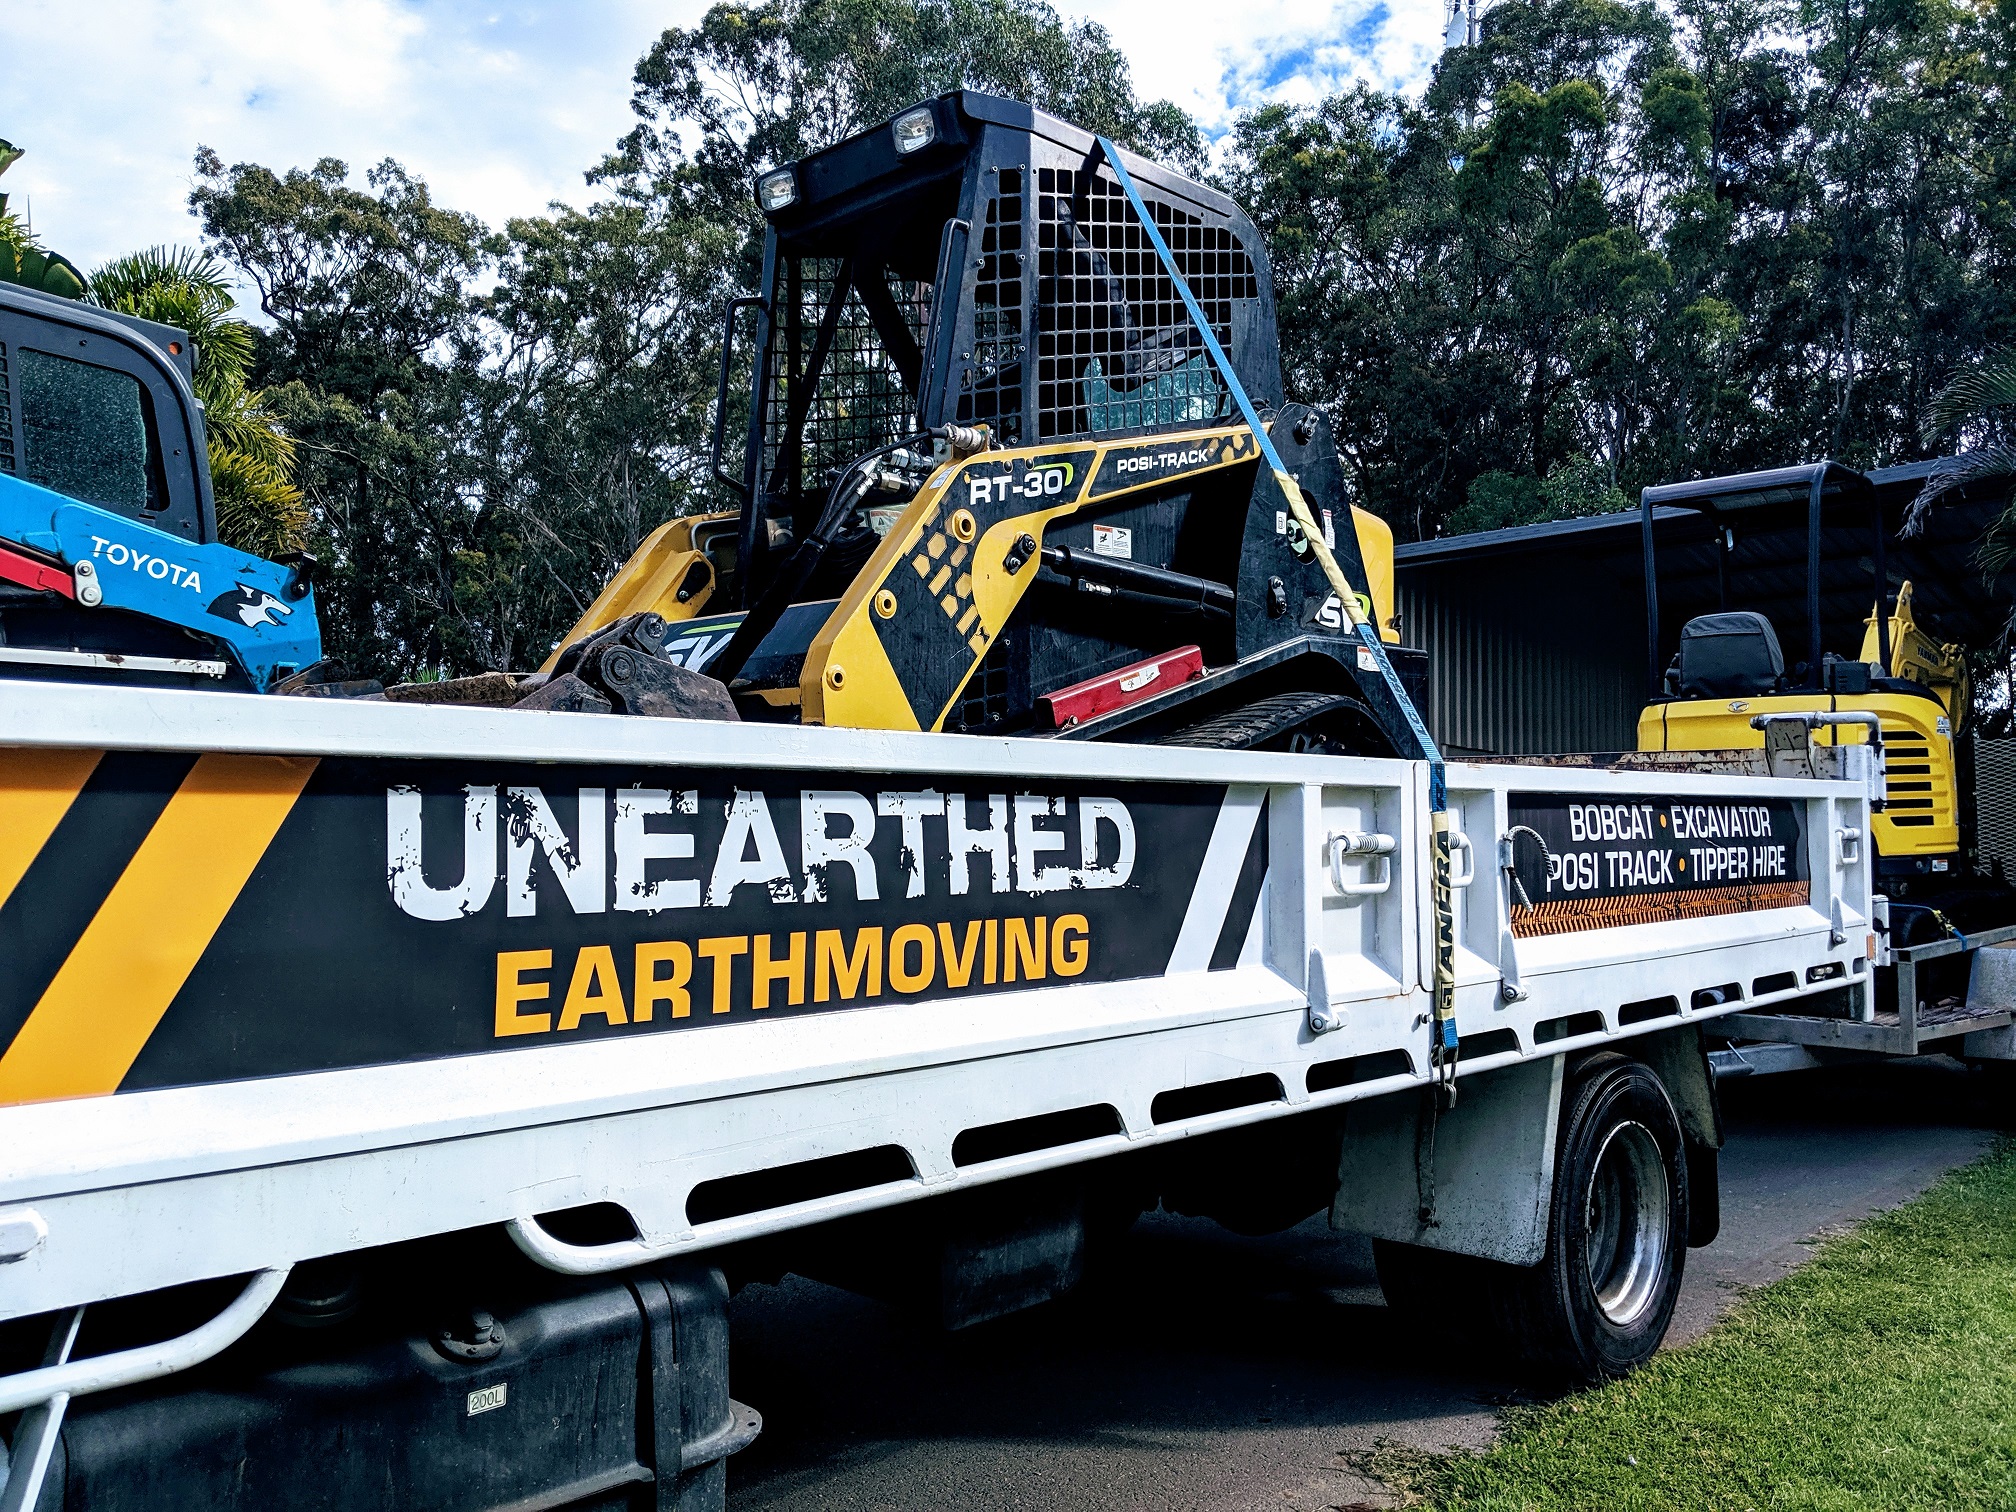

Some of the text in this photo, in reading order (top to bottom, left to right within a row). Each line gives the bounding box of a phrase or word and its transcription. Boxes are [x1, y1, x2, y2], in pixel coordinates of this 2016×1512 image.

[1117, 449, 1208, 473] POSI-TRACK
[970, 469, 1063, 505] RT-30
[92, 537, 201, 594] TOYOTA
[1569, 805, 1771, 841] BOBCAT EXCAVATOR
[387, 784, 1137, 920] UNEARTHED
[1546, 845, 1786, 893] POSI TRACK TIPPER HIRE
[494, 913, 1091, 1035] EARTHMOVING
[471, 1390, 502, 1411] 200L
